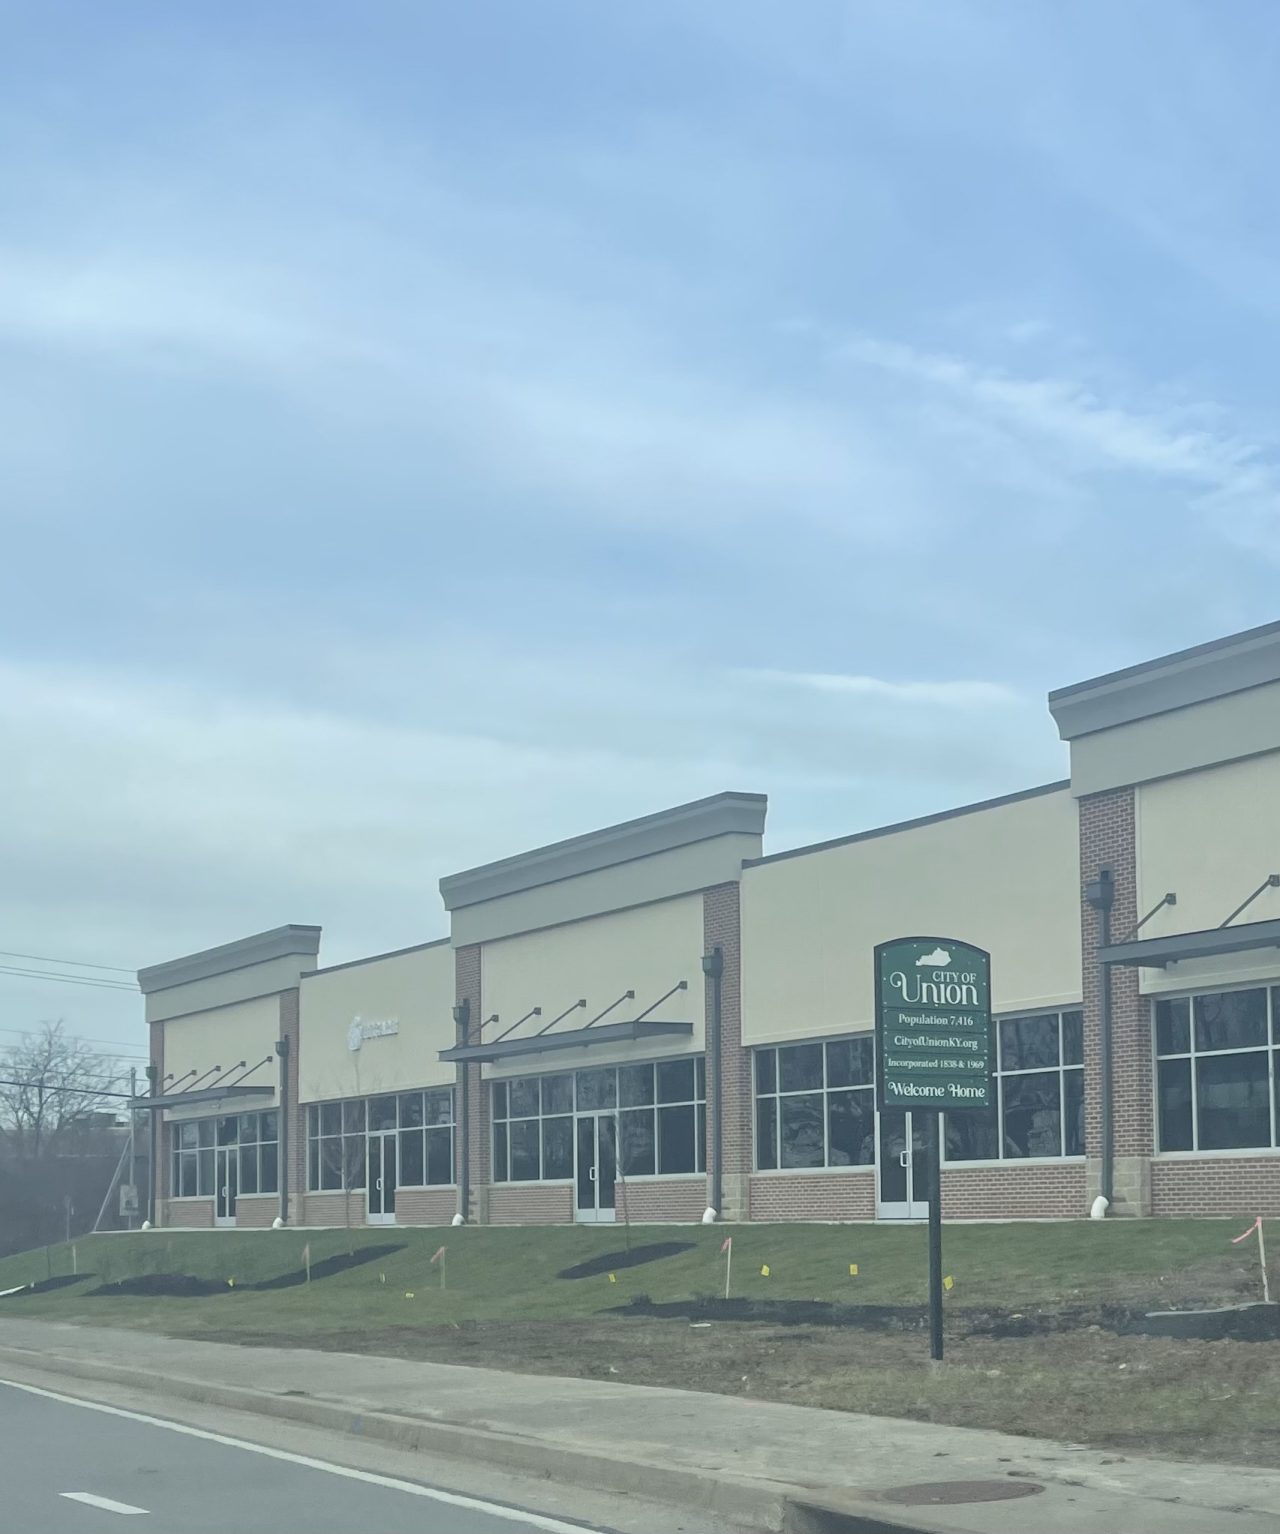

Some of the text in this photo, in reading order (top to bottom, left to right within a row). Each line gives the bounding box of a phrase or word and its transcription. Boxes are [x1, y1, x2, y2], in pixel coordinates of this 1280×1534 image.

[932, 971, 977, 984] CITY OF
[889, 971, 979, 1006] Union
[899, 1013, 948, 1026] Population
[894, 1035, 978, 1051] CityofUnionKY.org
[888, 1058, 938, 1069] Incorporated
[967, 1061, 985, 1069] 1969
[888, 1081, 986, 1098] Welcome Home
